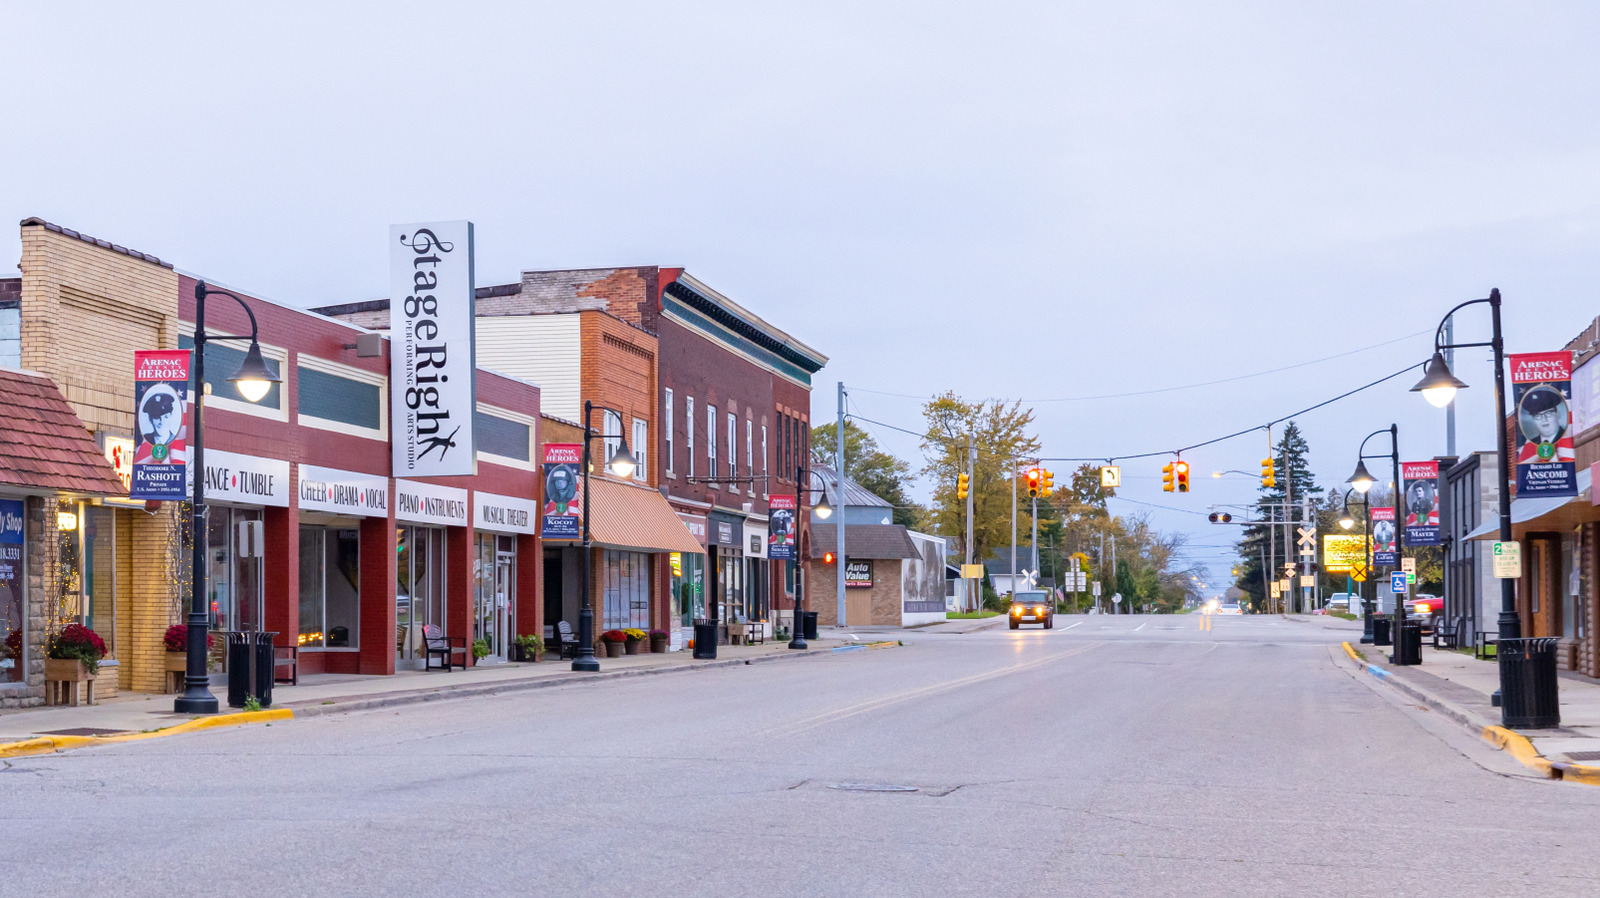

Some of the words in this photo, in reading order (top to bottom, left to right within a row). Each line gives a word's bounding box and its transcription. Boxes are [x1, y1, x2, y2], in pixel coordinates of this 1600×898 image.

[405, 320, 414, 385] PERFORMING
[142, 357, 182, 366] ARENAC
[1518, 360, 1563, 369] ARENAC
[138, 369, 186, 379] HEROES
[1514, 369, 1569, 381] HEROES
[407, 412, 415, 434] ARTS
[408, 435, 416, 470] STUDIO
[137, 470, 182, 481] RASHOTT
[1525, 470, 1568, 480] ANSCOMB
[204, 466, 229, 491] ANCE
[239, 470, 274, 497] TUMBLE
[300, 479, 327, 503] CHEER
[333, 484, 359, 507] DRAMA
[365, 488, 387, 510] VOCAL
[399, 492, 419, 514] PIANO
[425, 496, 465, 520] INSTRUMENTS
[482, 504, 505, 525] MUSICAL
[507, 508, 528, 527] THEATER
[6, 512, 23, 535] Shop
[1495, 545, 1501, 554] 2
[847, 562, 869, 572] Auto
[845, 571, 870, 580] Value
